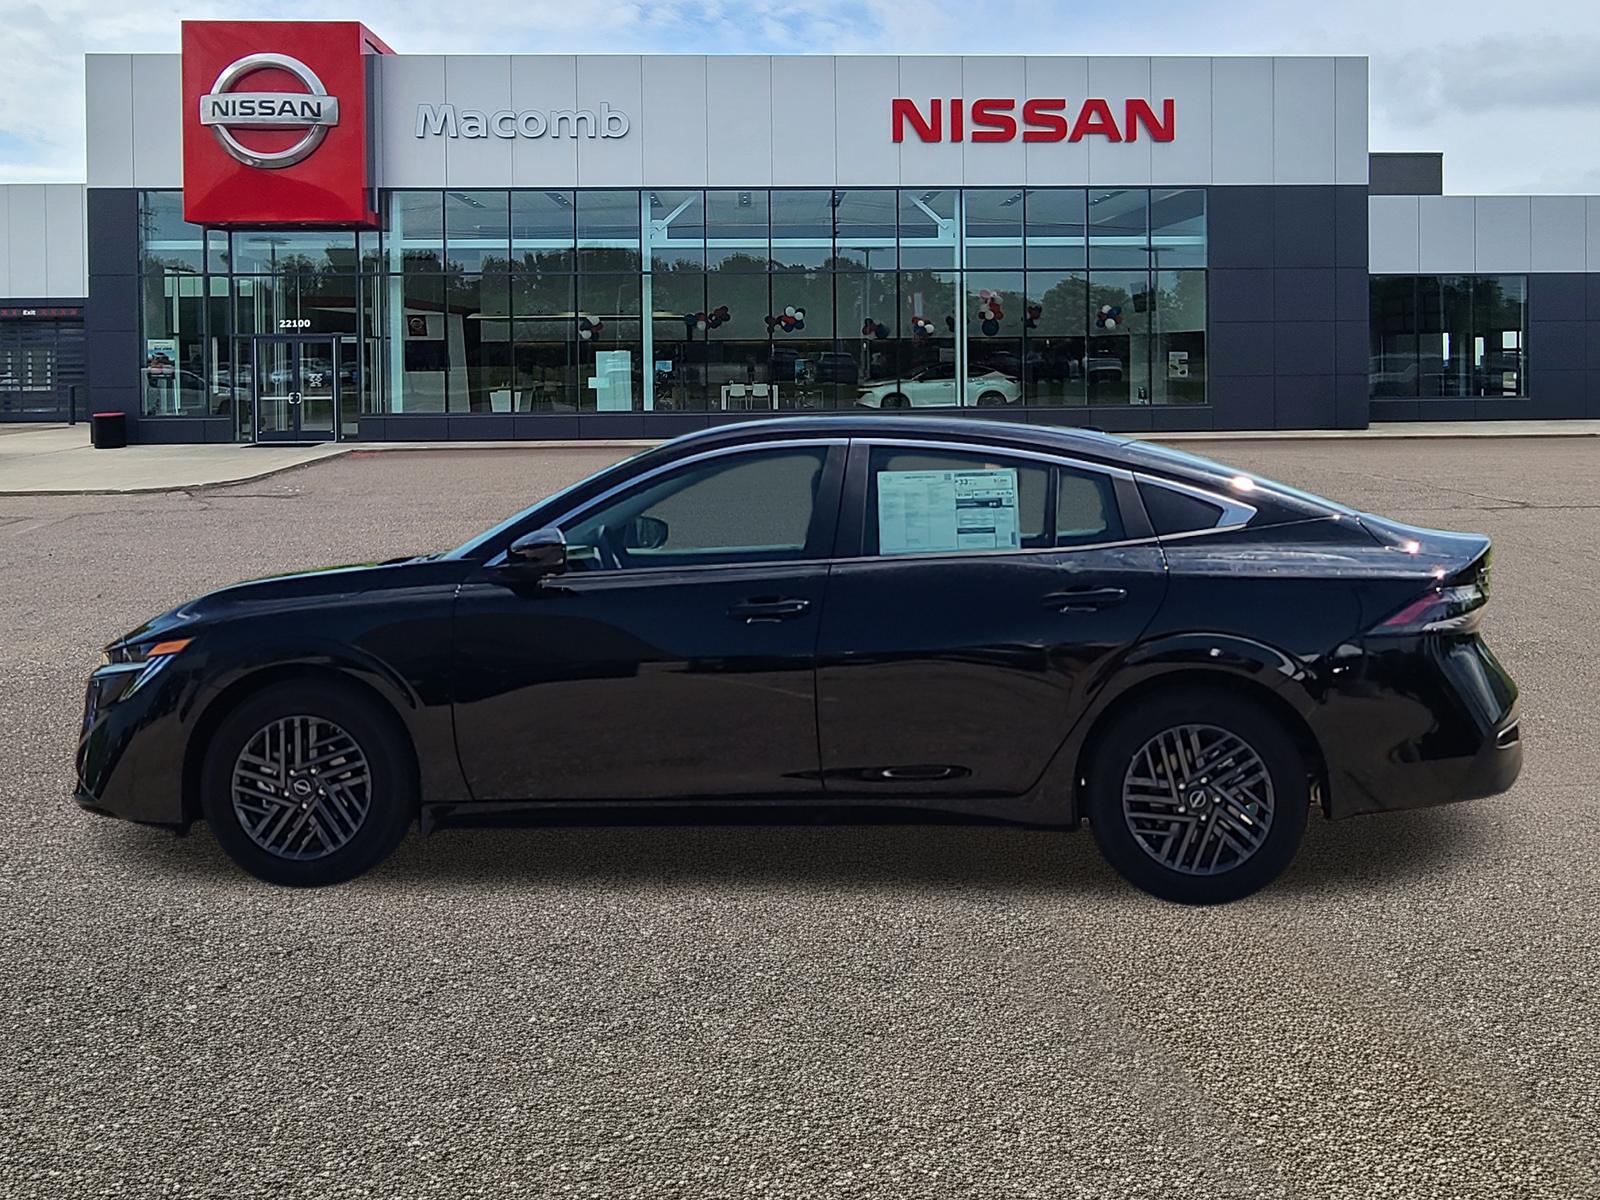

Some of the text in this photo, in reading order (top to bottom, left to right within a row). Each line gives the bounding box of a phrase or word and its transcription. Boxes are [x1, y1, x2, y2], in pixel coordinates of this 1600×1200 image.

[211, 100, 322, 117] NISSAN
[415, 102, 630, 139] Macomb
[892, 98, 1175, 143] NISSAN
[279, 319, 311, 328] 22100
